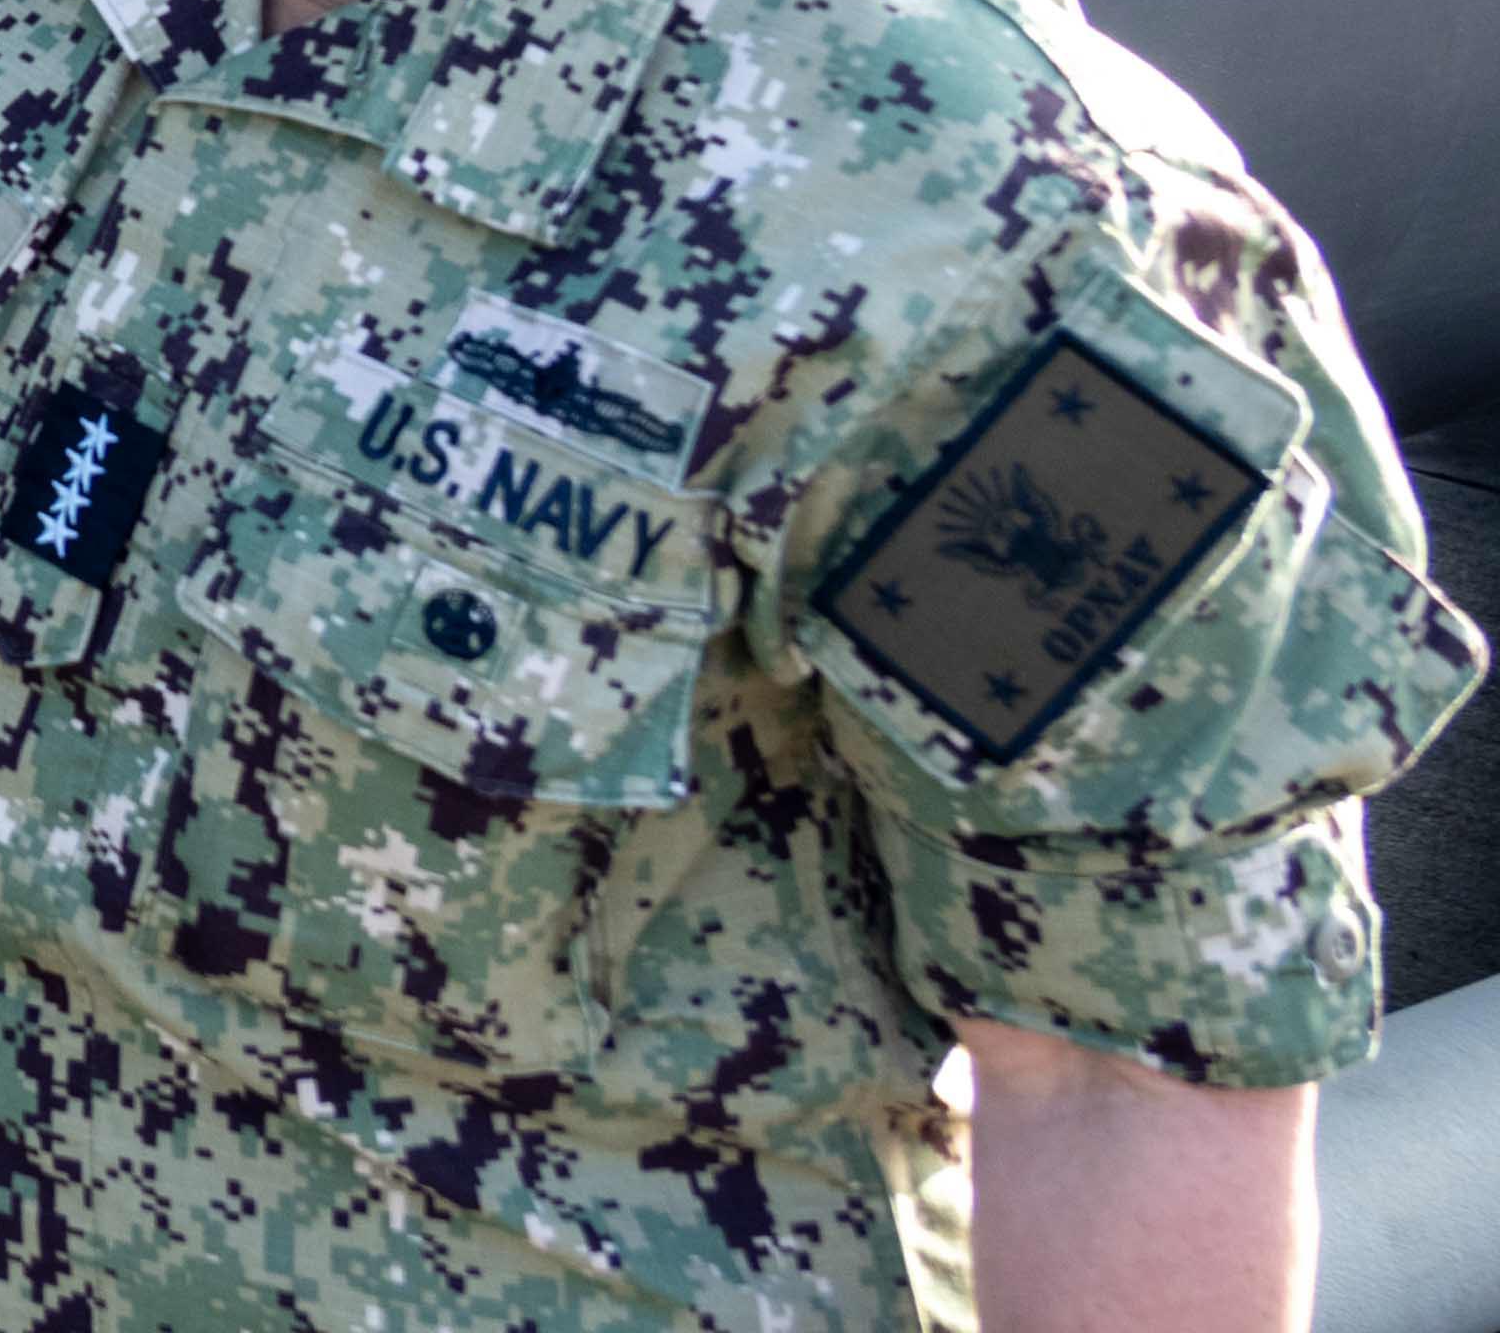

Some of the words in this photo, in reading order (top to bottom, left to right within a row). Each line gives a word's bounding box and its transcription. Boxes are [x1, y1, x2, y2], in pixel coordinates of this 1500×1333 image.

[357, 393, 460, 498] U.S.
[478, 448, 675, 578] NAVY
[1041, 535, 1163, 663] OPNAV
